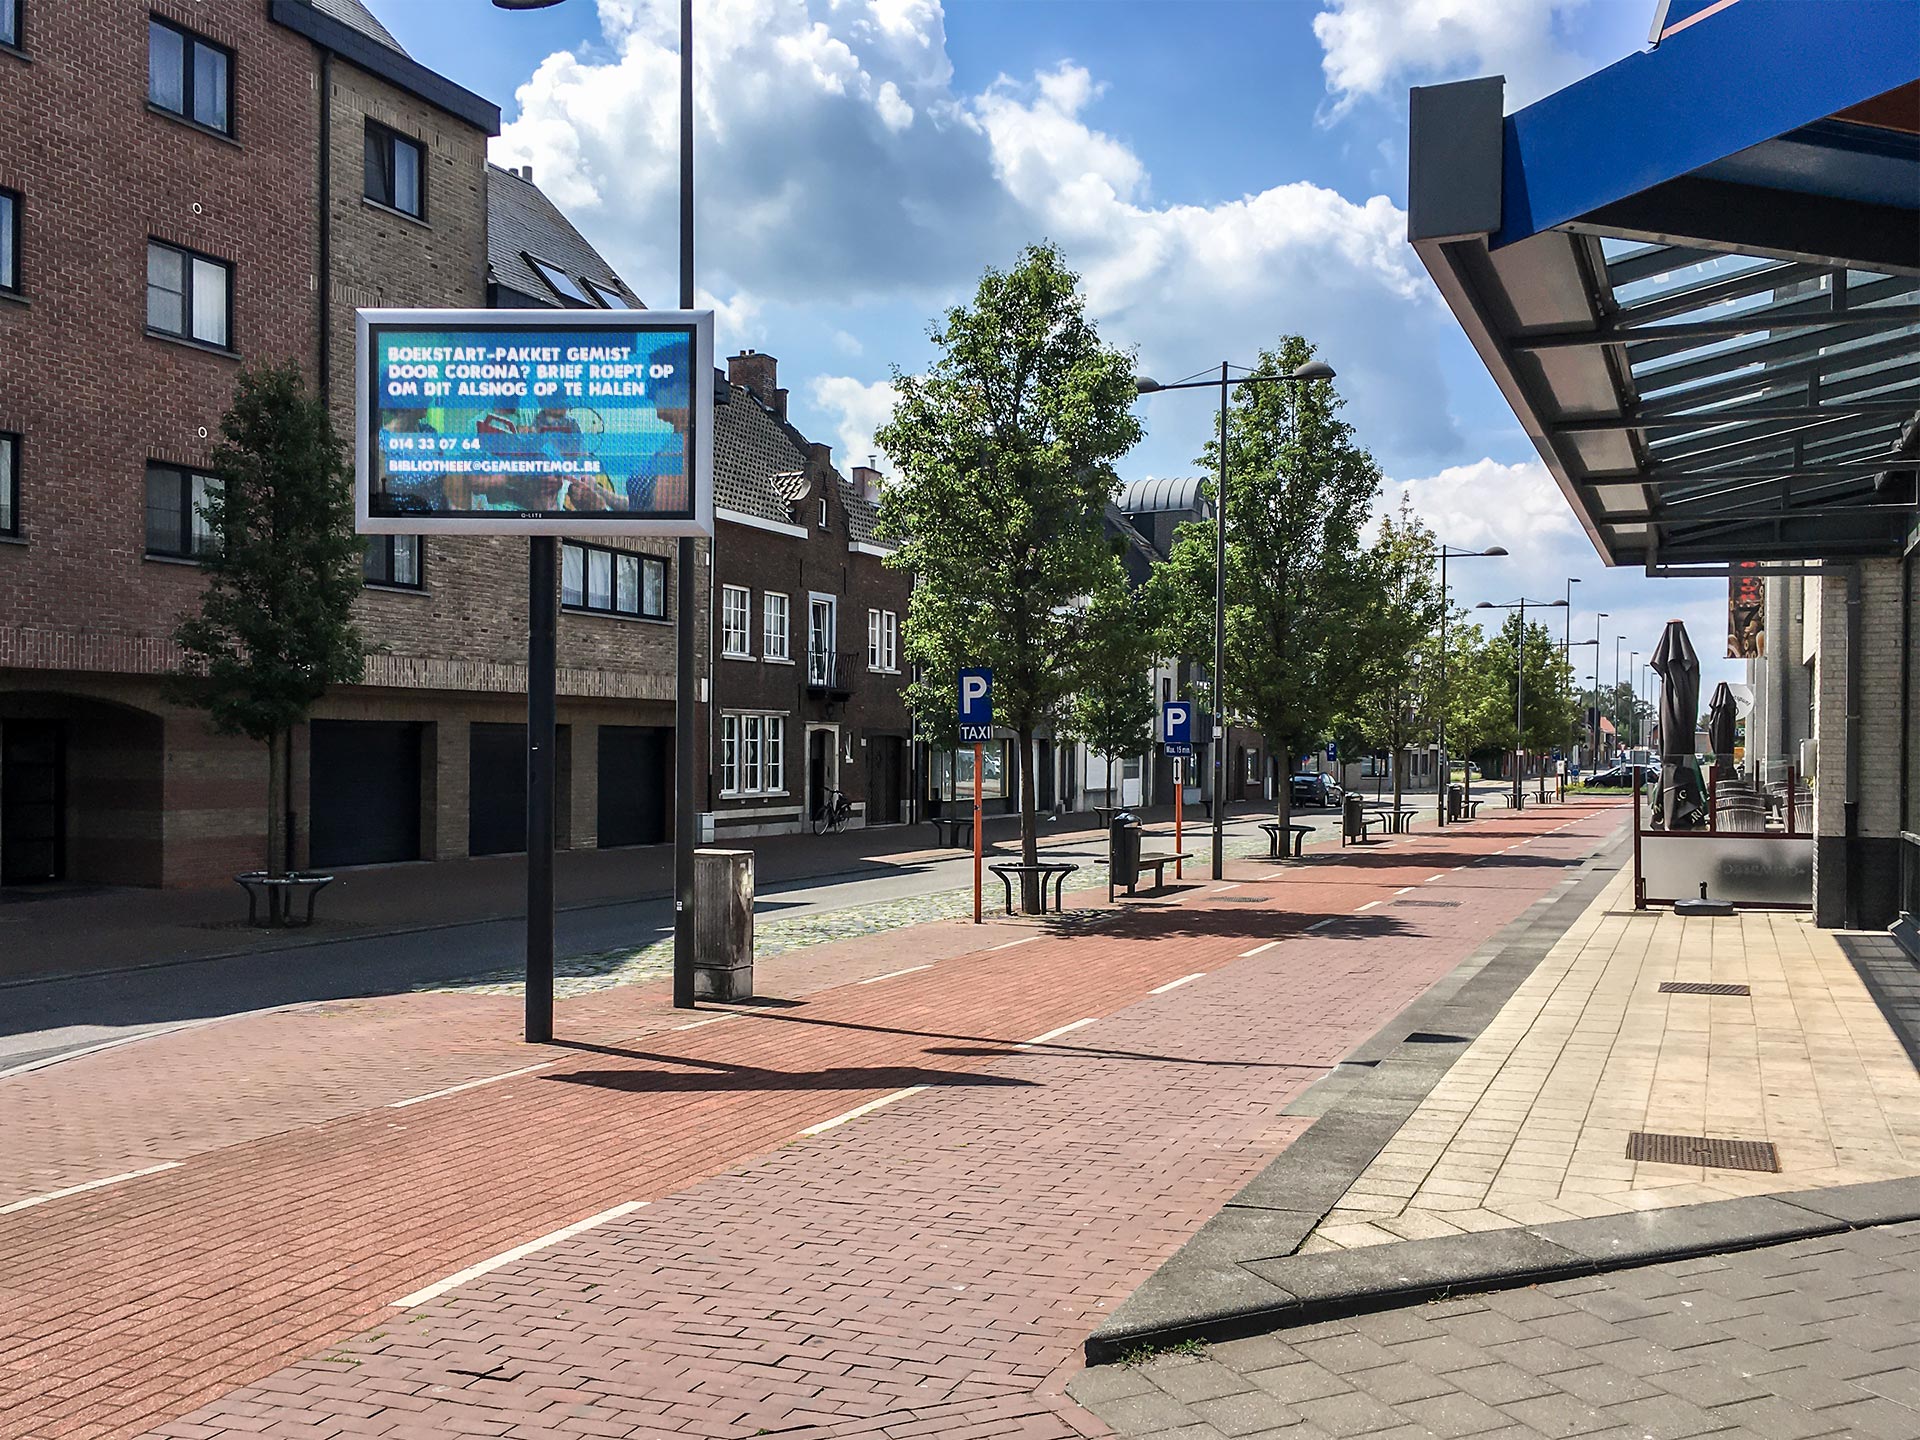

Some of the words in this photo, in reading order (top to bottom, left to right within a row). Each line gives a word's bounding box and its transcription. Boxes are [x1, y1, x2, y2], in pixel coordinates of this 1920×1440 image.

[388, 347, 560, 361] BOEKSTART-PAKKET
[567, 347, 631, 361] GEMIST
[389, 364, 438, 379] DOOR
[445, 364, 530, 379] CORONA?
[537, 364, 583, 379] BRIEF
[590, 364, 643, 379] ROEPT
[649, 364, 674, 379] OP
[388, 381, 418, 396] OM
[424, 381, 452, 396] DIT
[458, 381, 527, 396] ALSNOG
[534, 382, 557, 396] OP
[564, 382, 582, 396] TE
[589, 382, 645, 396] HALEN
[389, 438, 413, 450] 014
[418, 438, 435, 450] 33
[439, 438, 457, 450] 07
[462, 438, 480, 450] 64
[389, 460, 600, 472] BIBLIOTHEEK@GEMEENTEMOL.BE
[963, 676, 987, 714] P
[1167, 708, 1187, 736] P
[961, 726, 990, 739] TAXI
